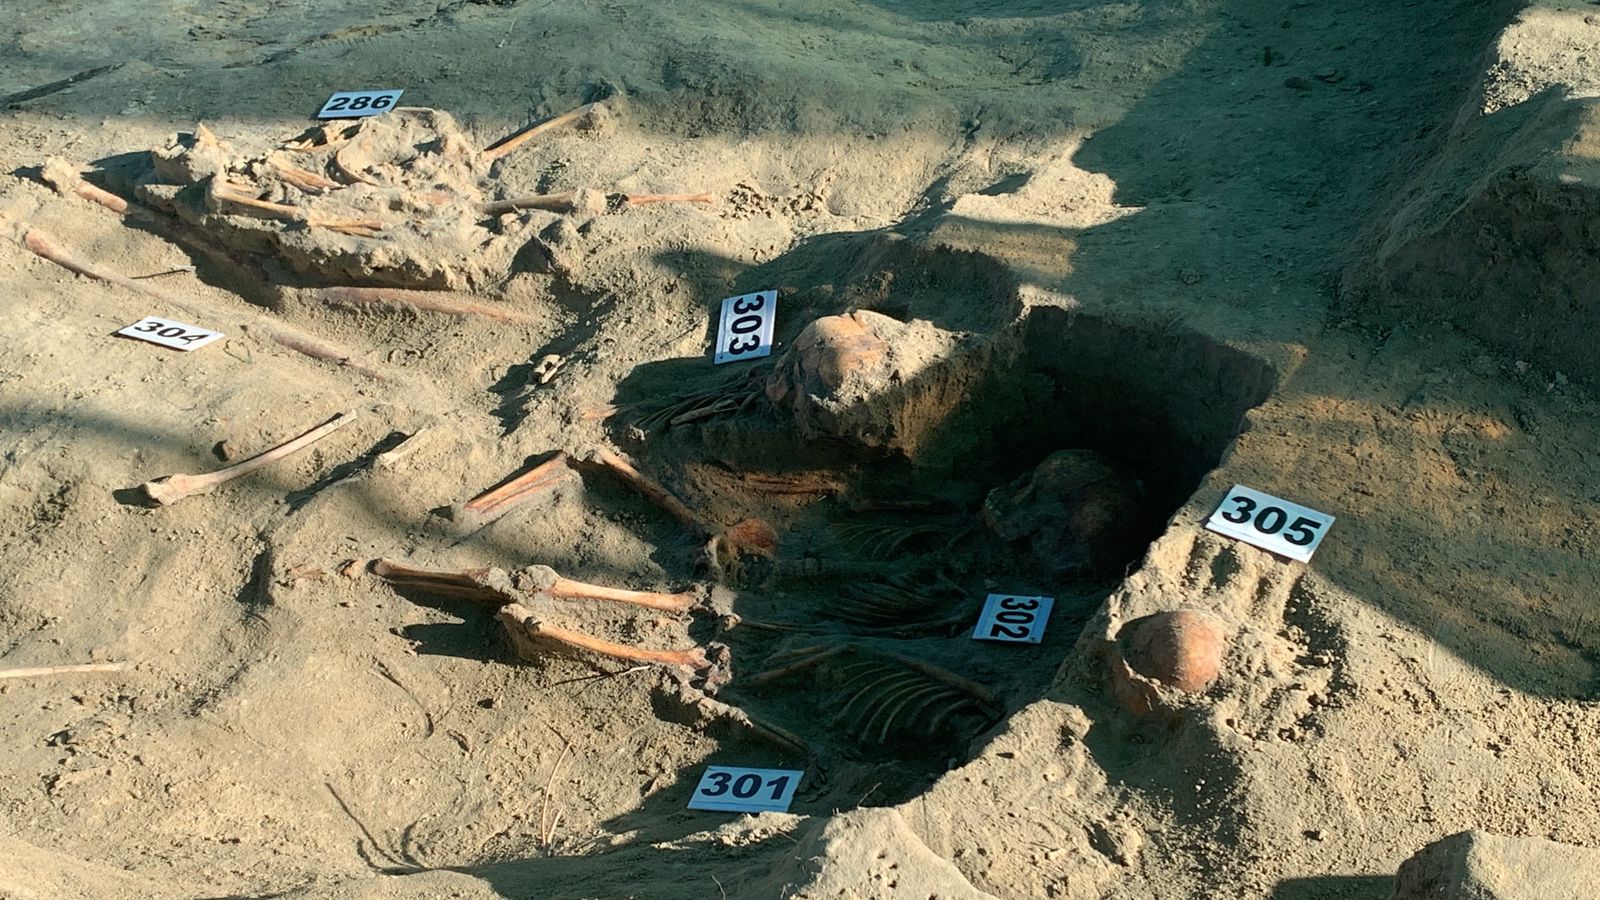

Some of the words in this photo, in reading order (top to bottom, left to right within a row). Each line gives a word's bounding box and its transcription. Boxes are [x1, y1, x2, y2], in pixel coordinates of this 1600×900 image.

[325, 95, 394, 111] 286
[134, 321, 210, 345] 304
[728, 294, 765, 356] 303
[1221, 495, 1322, 546] 305
[989, 597, 1040, 639] 302
[700, 772, 790, 800] 301
